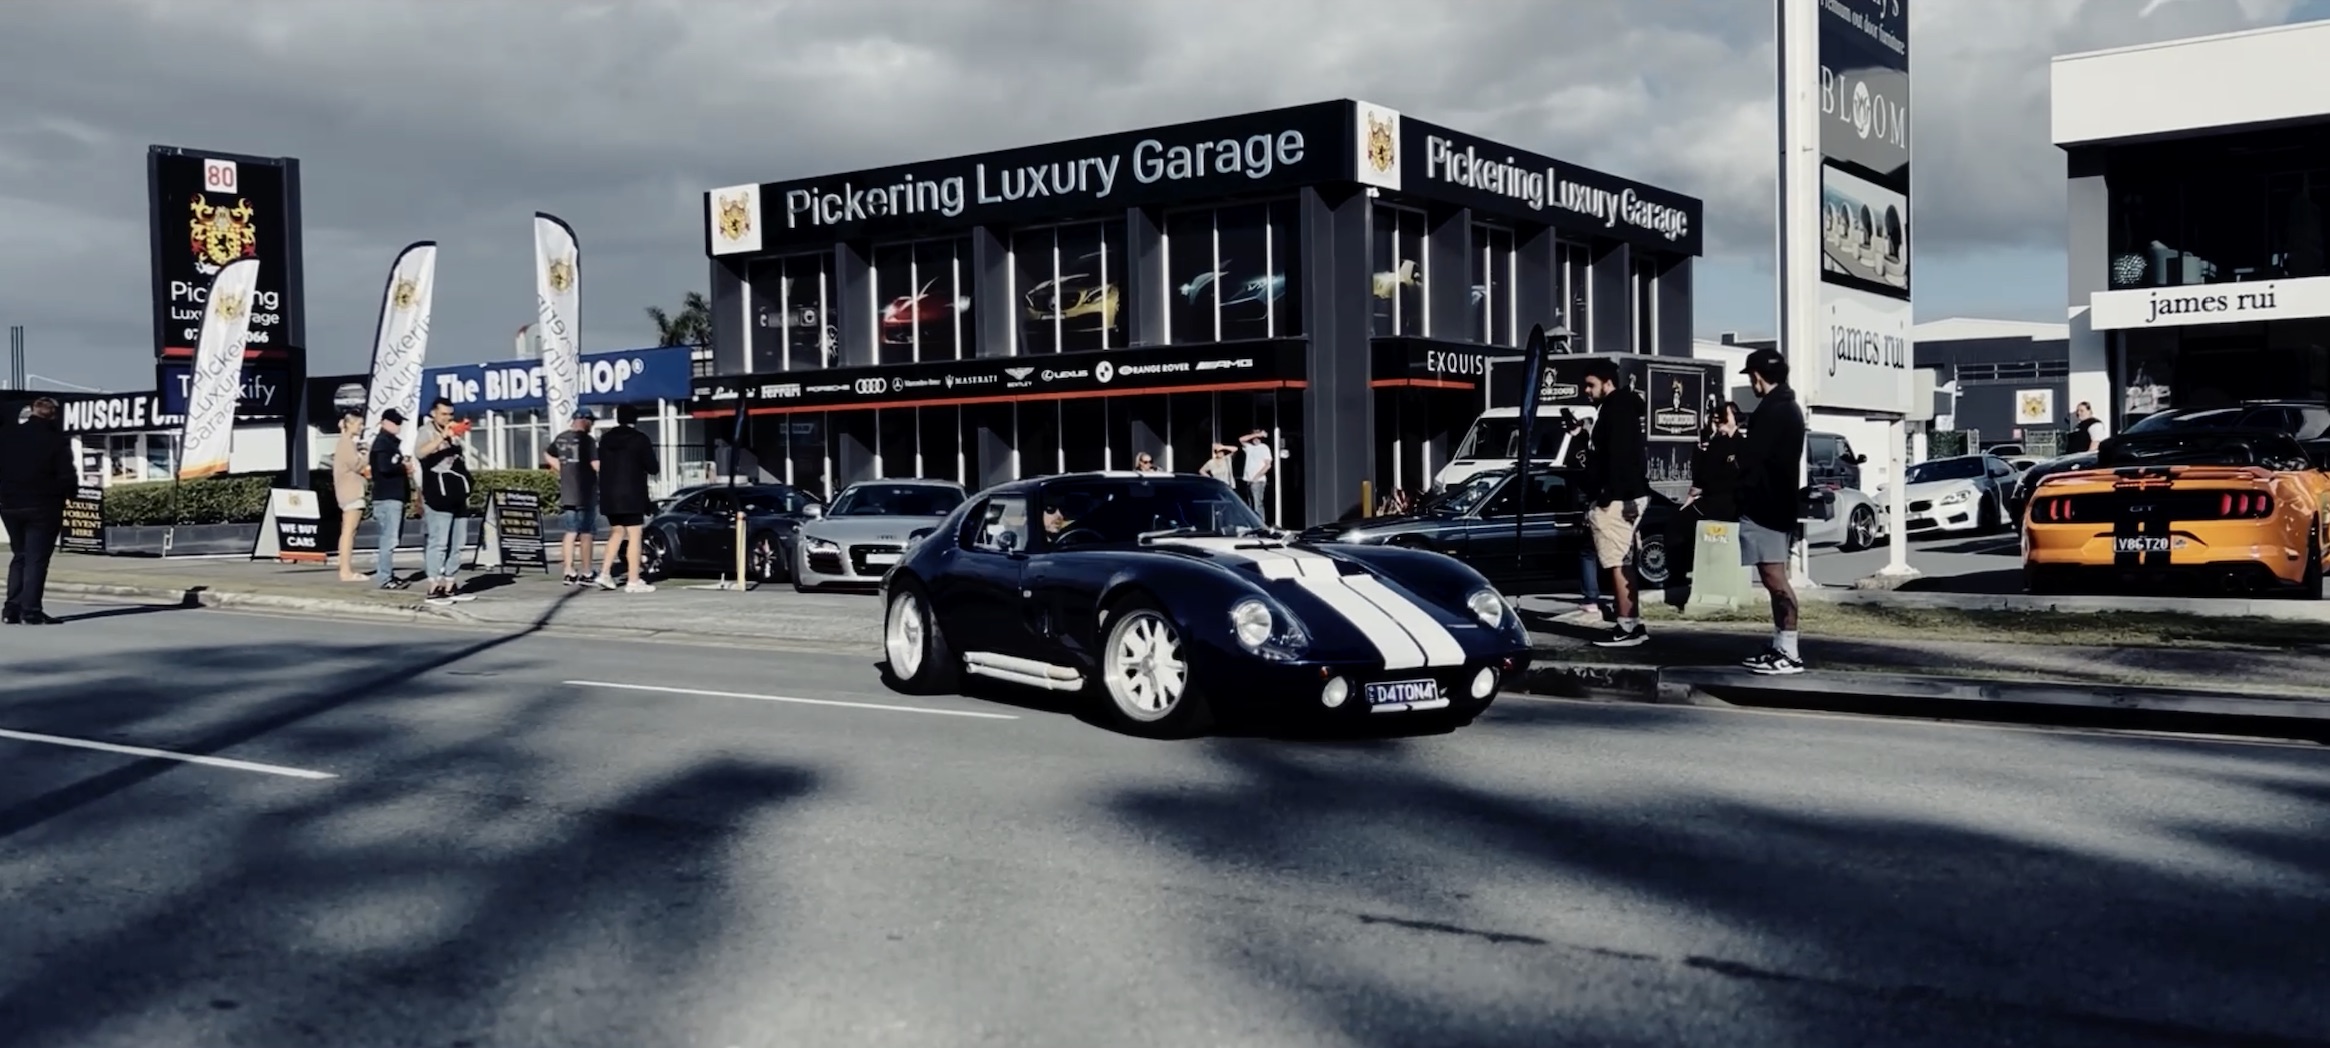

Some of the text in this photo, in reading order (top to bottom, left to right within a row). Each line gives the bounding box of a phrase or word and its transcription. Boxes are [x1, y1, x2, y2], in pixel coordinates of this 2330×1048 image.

[1821, 65, 1905, 149] BLOOM
[207, 165, 234, 188] 80
[786, 129, 1305, 229] Pickering Luxury Garage
[1427, 135, 1688, 242] Pickering Luxury Garage
[171, 281, 279, 311] Picng
[2145, 284, 2277, 323] james rui
[1829, 305, 1905, 378] james rui
[955, 375, 997, 385] MASERATI
[1054, 370, 1088, 378] LEXUS
[1133, 364, 1161, 374] RANGE
[1162, 363, 1190, 372] ROVER
[1427, 351, 1485, 375] EXQUIS
[437, 372, 480, 403] The
[485, 368, 543, 400] BIDE
[63, 397, 146, 432] MUSCLE
[63, 510, 101, 520] FORMAL
[72, 520, 101, 529] EVENT
[280, 523, 318, 535] WE BUY
[287, 536, 316, 548] CARS
[1377, 682, 1434, 703] D4TON4
